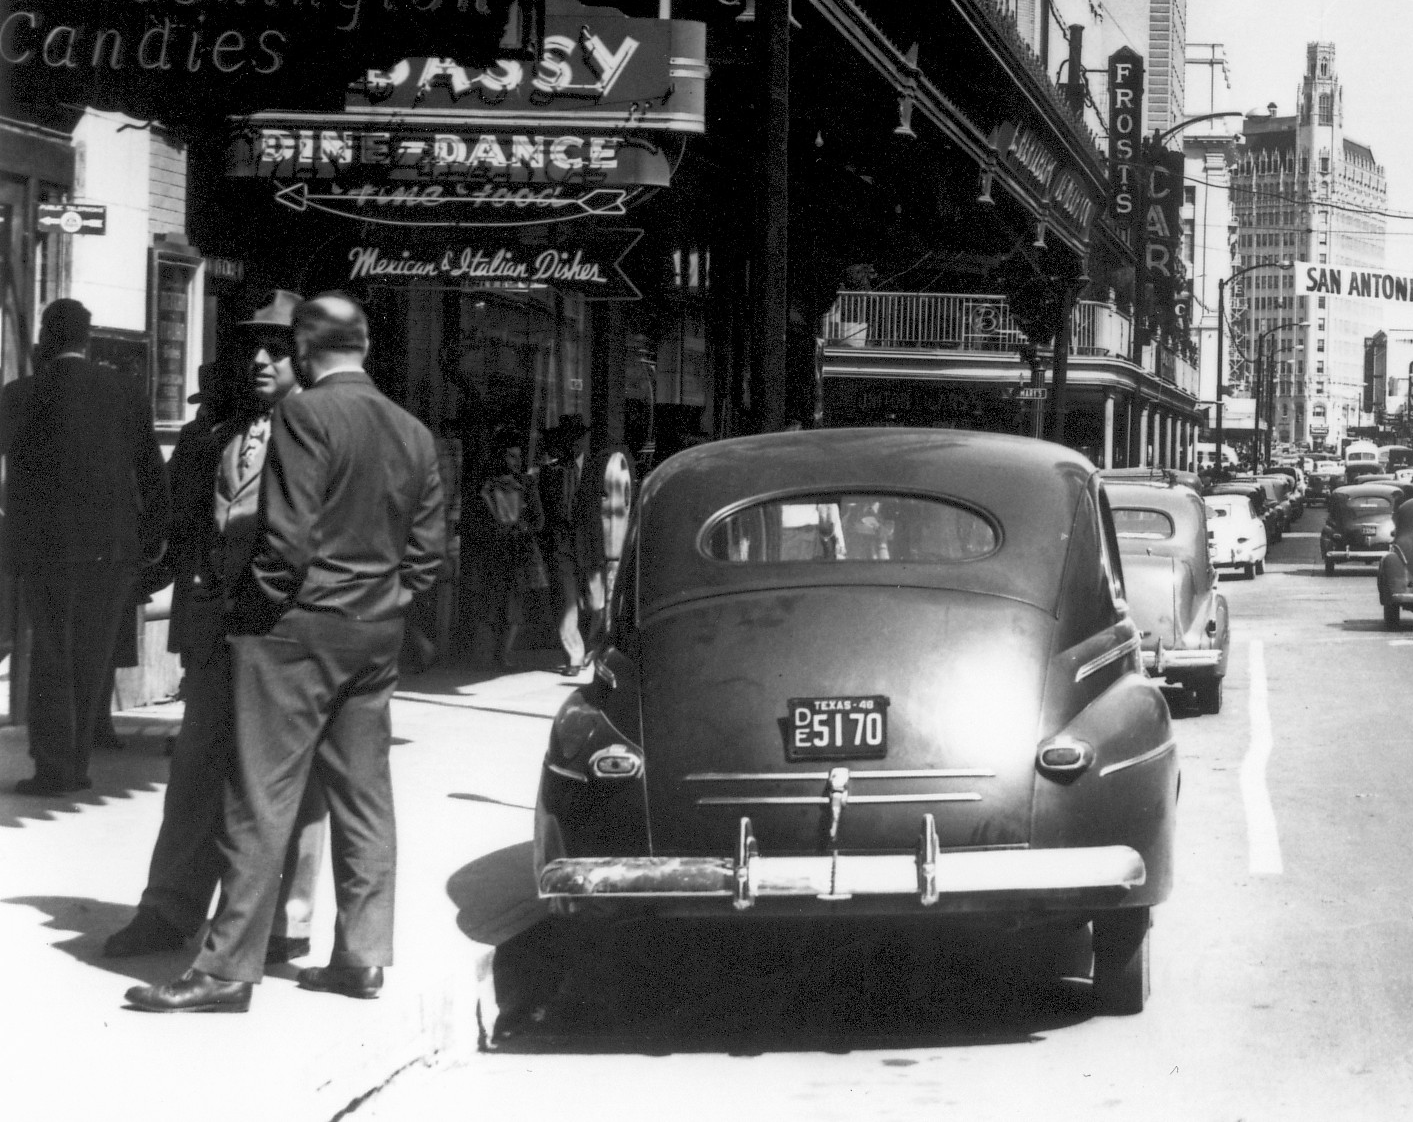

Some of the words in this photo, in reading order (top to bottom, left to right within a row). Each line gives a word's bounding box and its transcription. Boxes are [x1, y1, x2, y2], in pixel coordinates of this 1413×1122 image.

[0, 11, 287, 74] Candies
[349, 247, 438, 280] Mexican
[450, 247, 528, 278] Italian
[531, 249, 608, 282] Dishes
[1306, 267, 1341, 295] SAN
[813, 711, 882, 747] 5170
